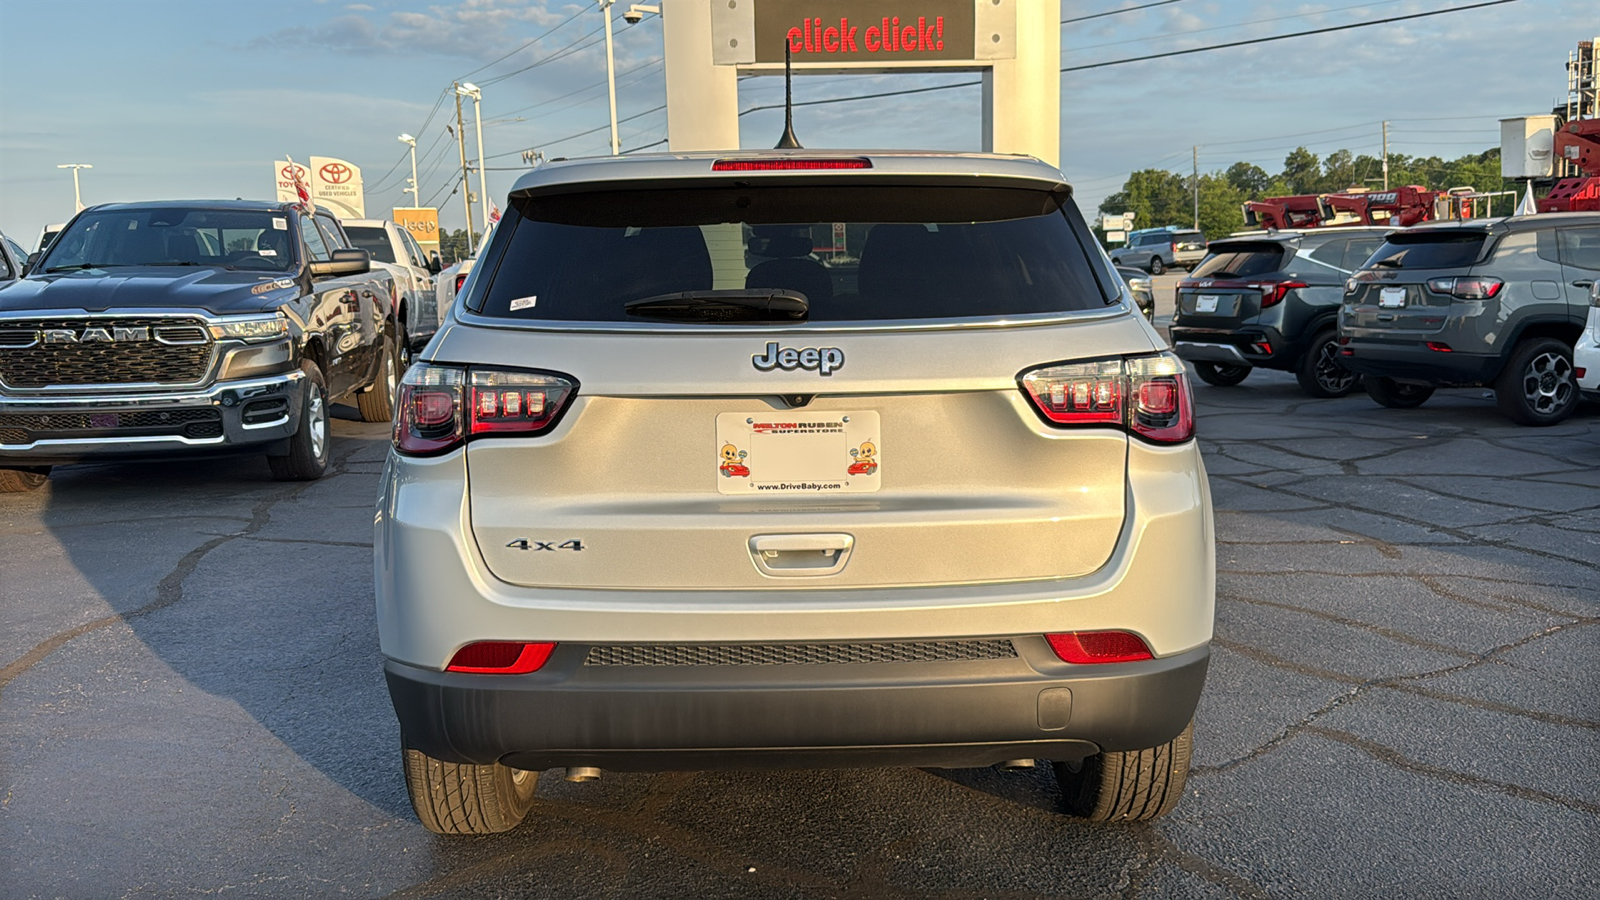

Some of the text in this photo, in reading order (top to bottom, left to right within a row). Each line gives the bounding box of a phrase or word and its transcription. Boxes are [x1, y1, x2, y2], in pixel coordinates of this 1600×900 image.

[787, 16, 944, 53] click click!
[43, 327, 149, 343] RAM
[751, 341, 845, 376] Jeep
[505, 537, 585, 552] 4x4
